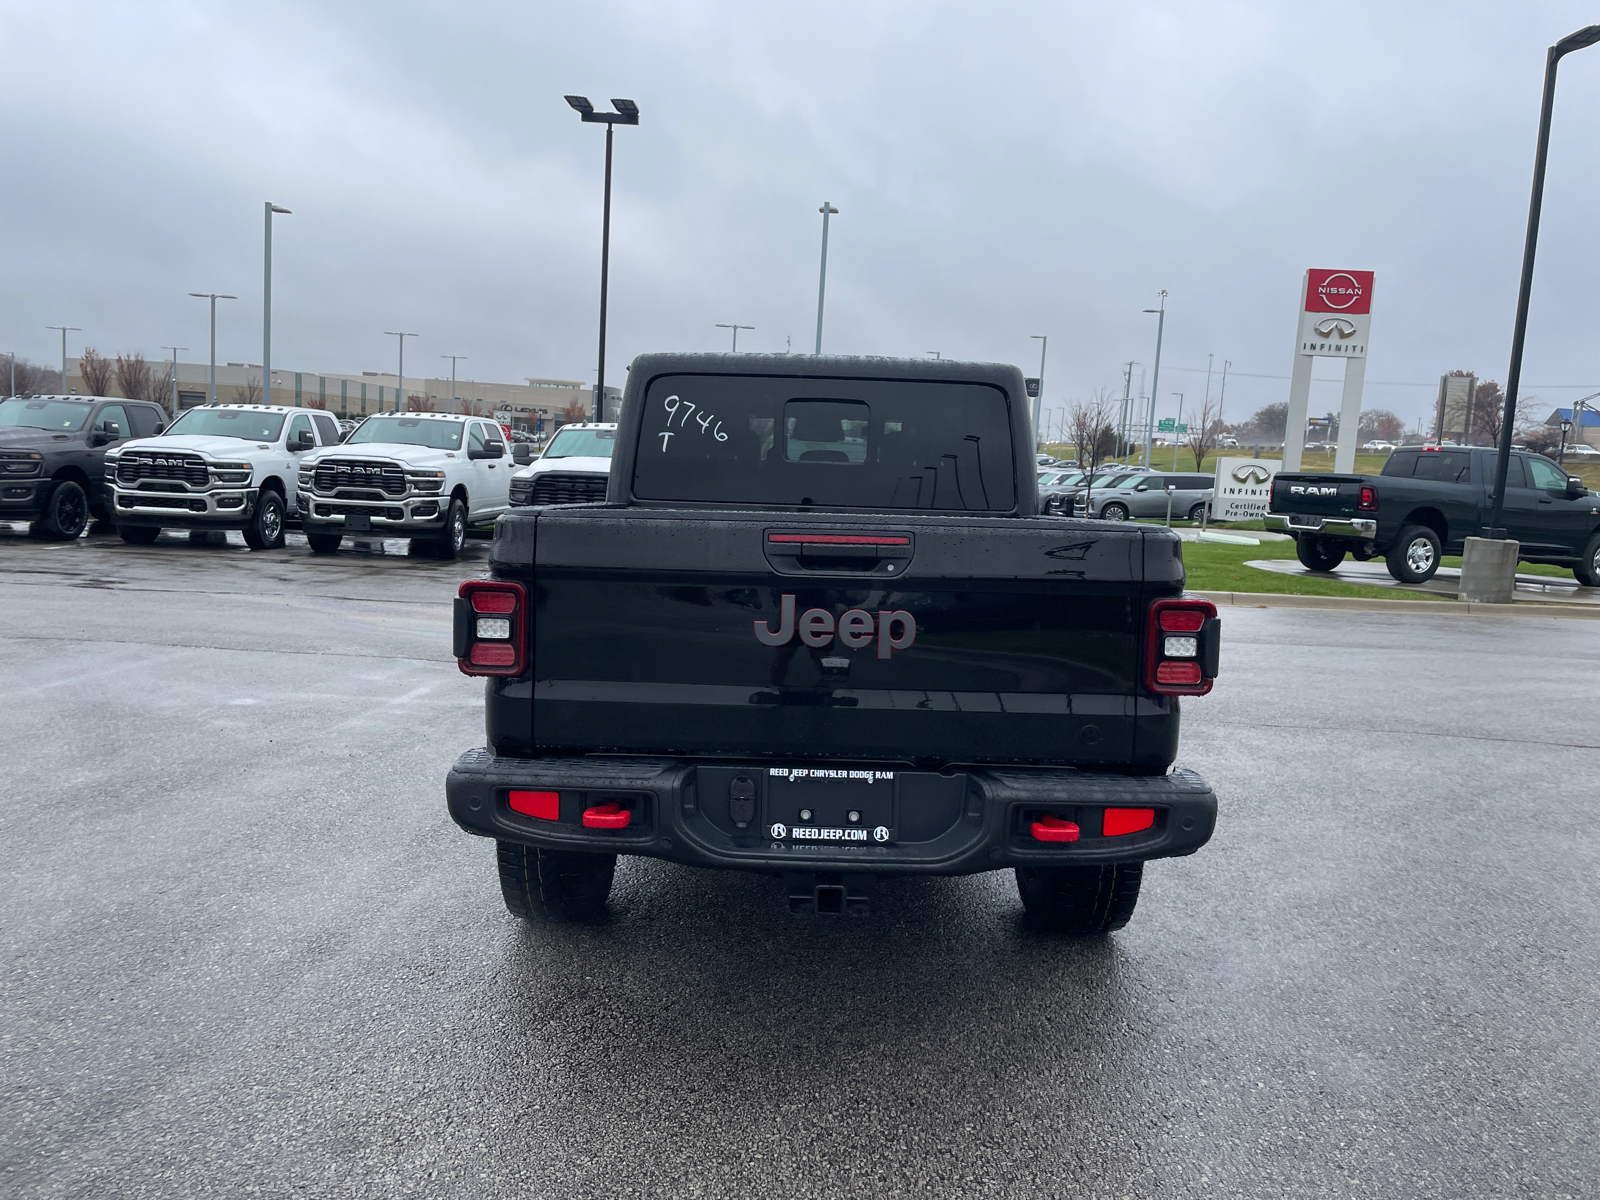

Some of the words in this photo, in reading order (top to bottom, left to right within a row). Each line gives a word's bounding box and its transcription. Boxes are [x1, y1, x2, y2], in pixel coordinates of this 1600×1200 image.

[1318, 287, 1362, 295] NISSAN
[1303, 342, 1364, 353] INFINITI
[664, 394, 728, 442] 9746
[658, 431, 675, 453] T
[140, 458, 183, 466] RAM
[337, 466, 381, 475] RAM
[1223, 487, 1270, 496] INFINIT
[1290, 486, 1337, 497] RAM
[1230, 502, 1266, 511] Certified
[1225, 510, 1265, 518] Pre-Owne
[753, 594, 917, 660] Jeep
[769, 768, 789, 777] REED
[791, 768, 808, 778] JEEP
[810, 769, 848, 778] CHRYSLER
[849, 770, 874, 779] DODGE
[875, 771, 894, 780] RAM
[792, 828, 867, 841] REEDJEEP.COM
